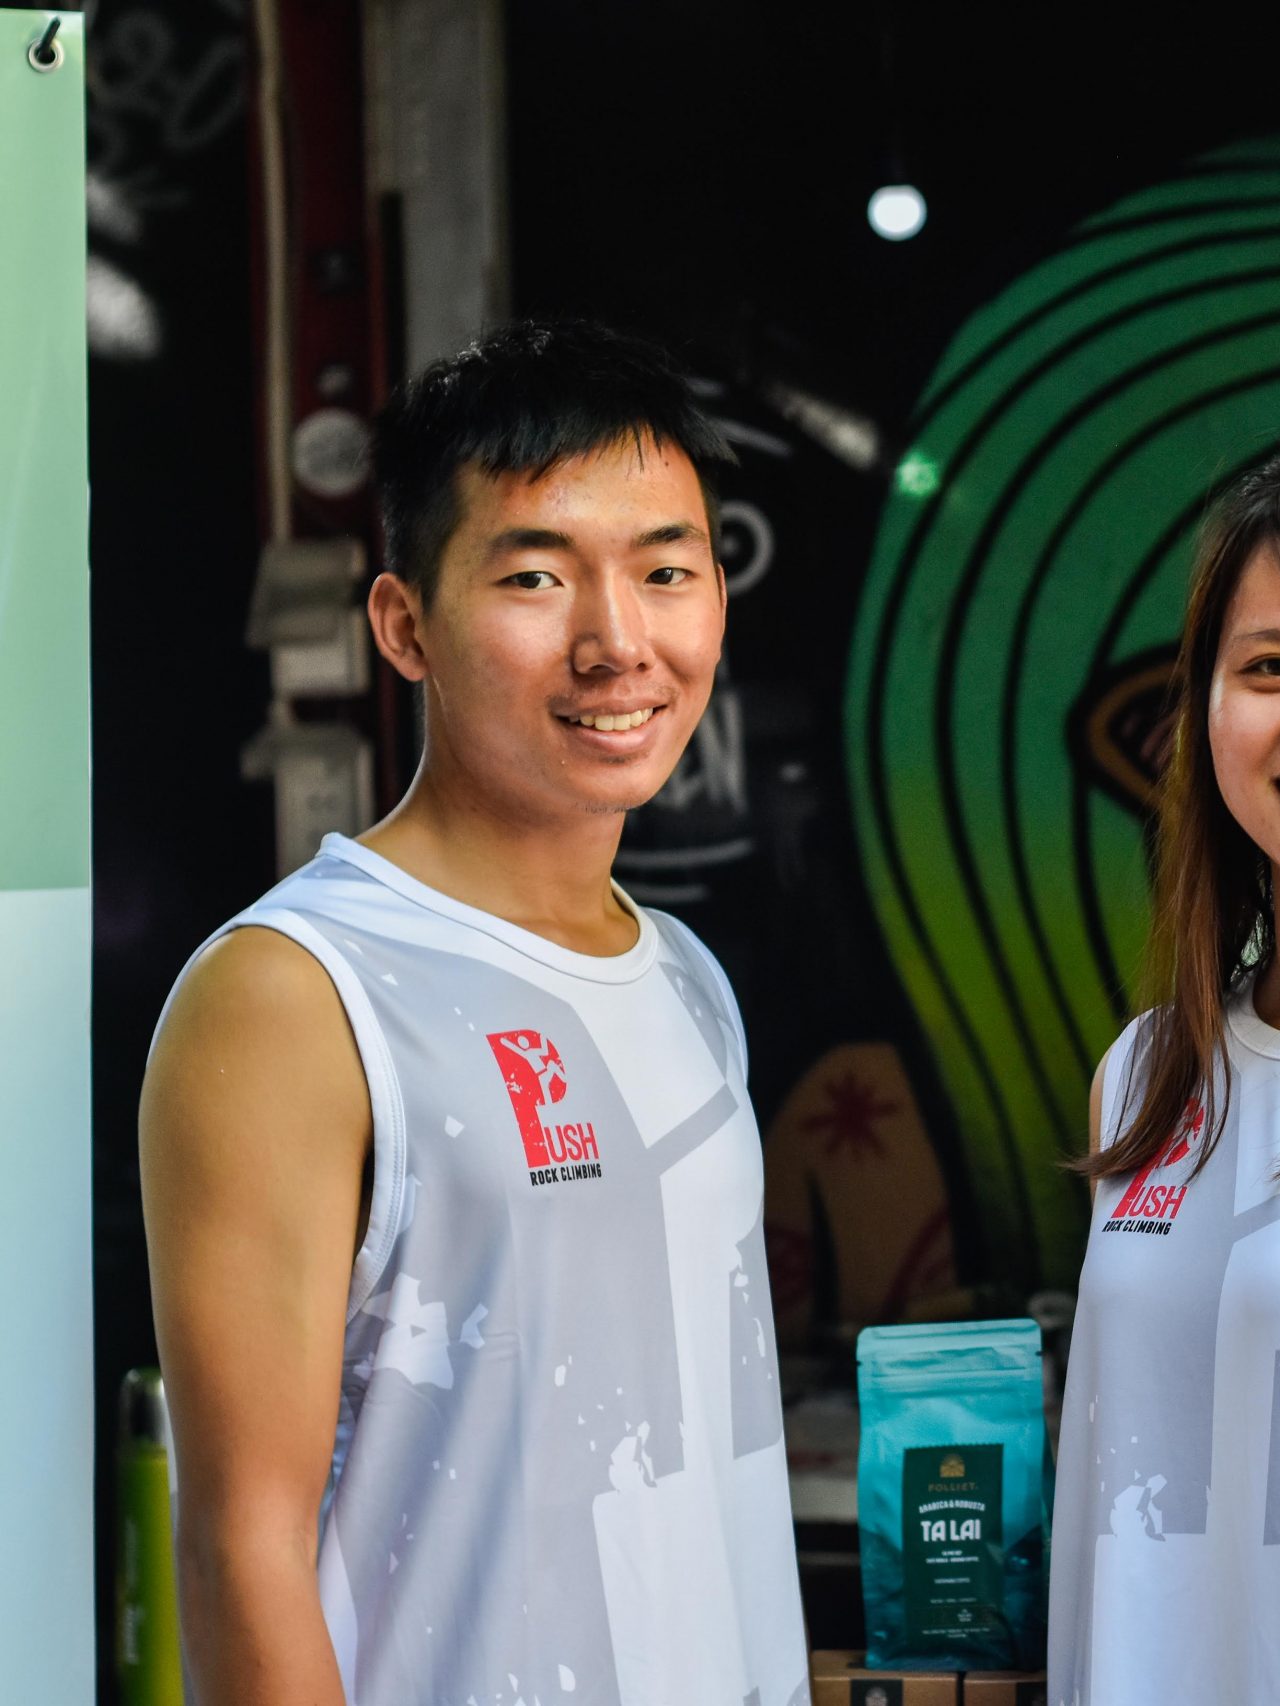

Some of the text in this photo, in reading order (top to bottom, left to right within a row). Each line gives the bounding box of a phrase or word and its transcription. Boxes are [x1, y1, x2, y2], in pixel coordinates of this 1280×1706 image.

[486, 1029, 599, 1168] PUSH
[530, 1163, 602, 1186] ROCK CLIMBING
[1102, 1220, 1172, 1235] ROCK CLIMBING
[920, 1519, 981, 1542] TA LAI
